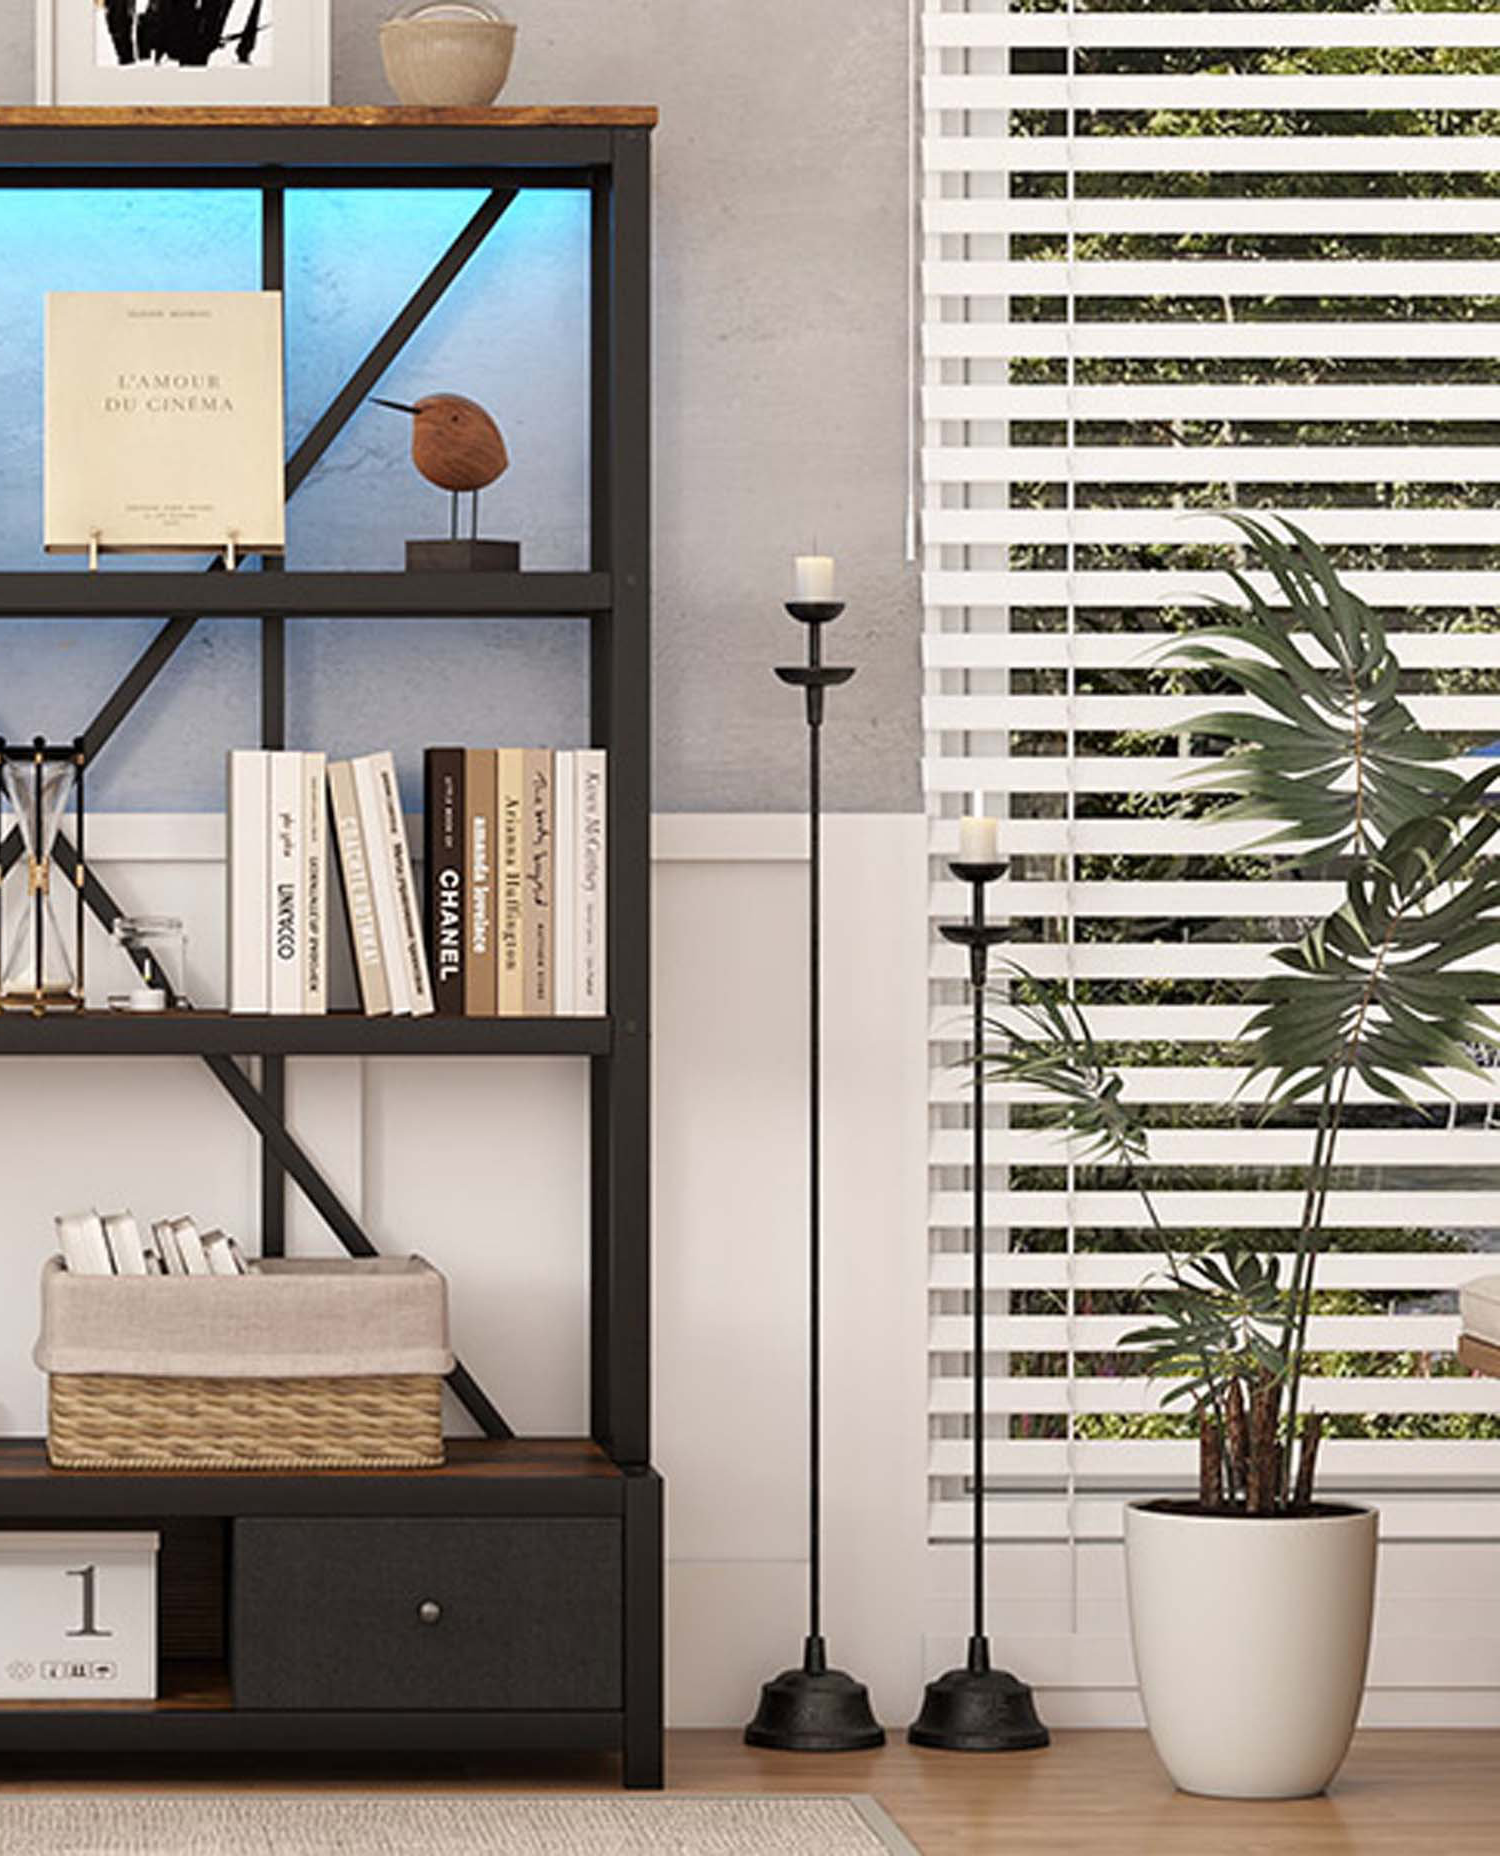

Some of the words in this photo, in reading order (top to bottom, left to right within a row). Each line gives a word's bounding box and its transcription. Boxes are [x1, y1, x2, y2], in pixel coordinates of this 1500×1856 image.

[104, 398, 137, 412] DU
[146, 395, 235, 412] CINÉMA
[118, 373, 221, 390] L'AMOUR
[473, 816, 489, 882] amanda
[505, 795, 520, 865] Arianna
[439, 868, 460, 982] CHANEL
[473, 886, 490, 954] lovelace
[503, 873, 520, 971] Huffington
[65, 1563, 113, 1638] 1
